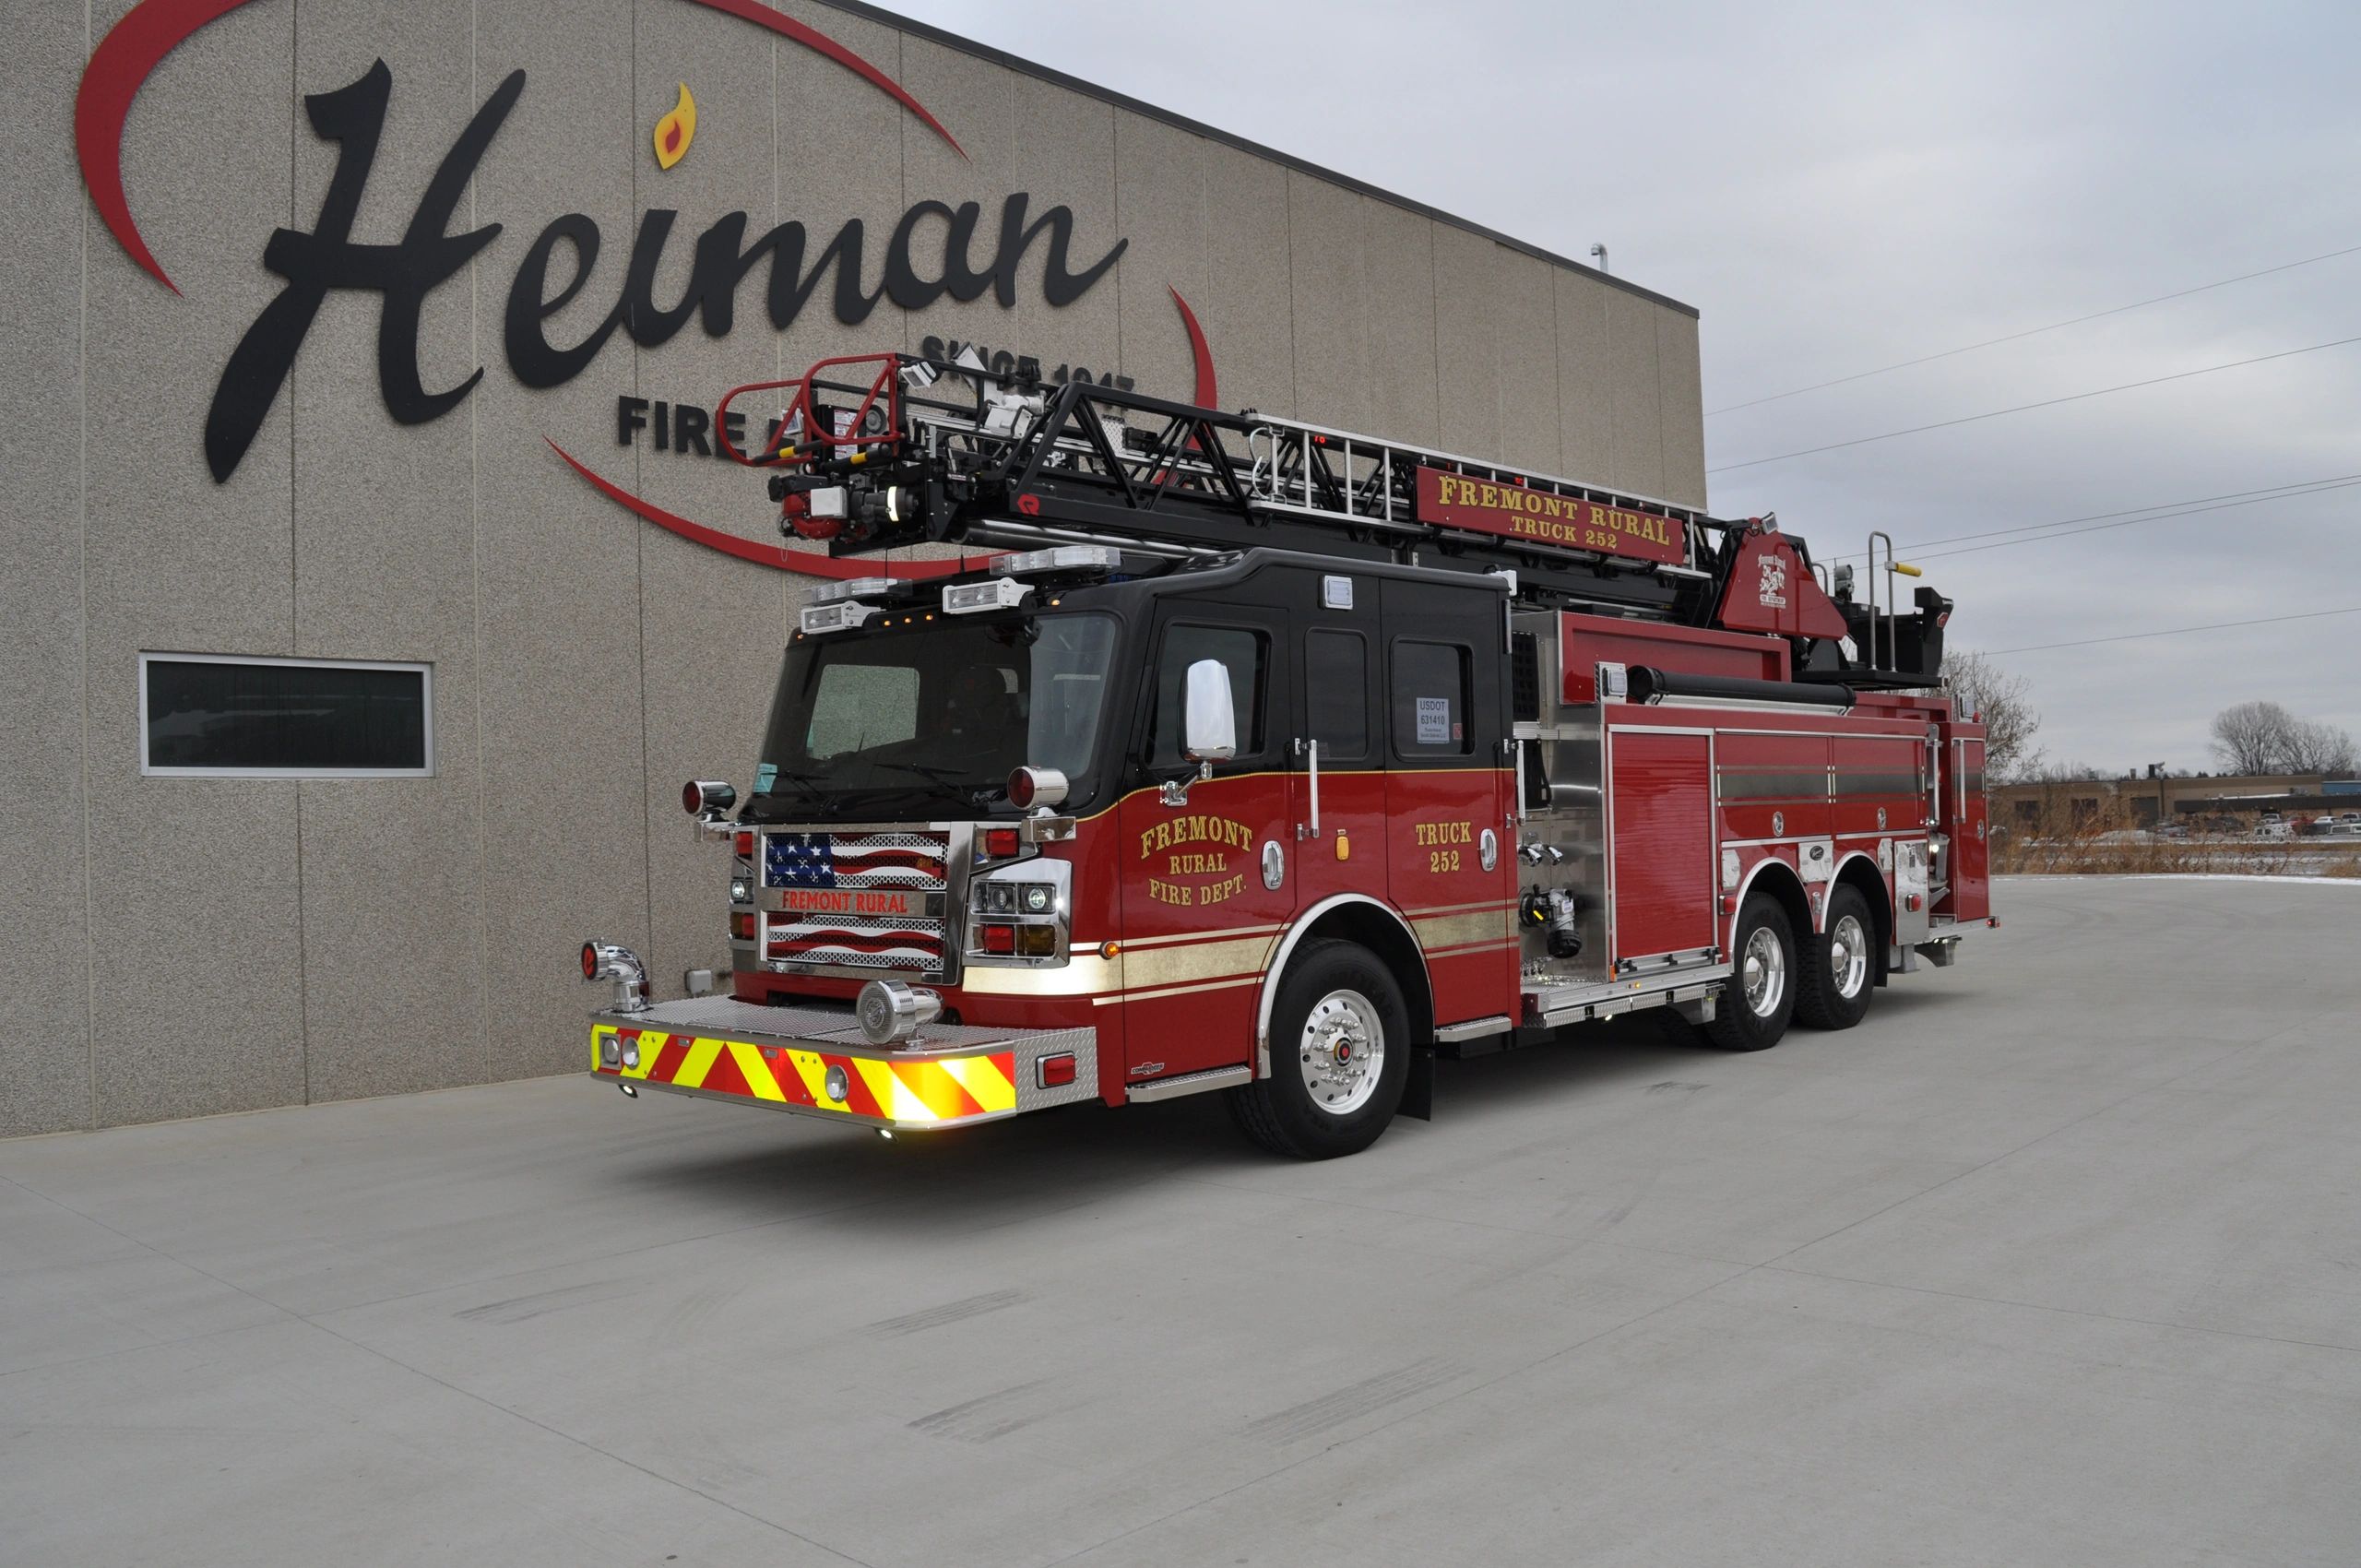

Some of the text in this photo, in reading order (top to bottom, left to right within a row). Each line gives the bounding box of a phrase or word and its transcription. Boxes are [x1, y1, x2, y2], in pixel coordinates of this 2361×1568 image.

[205, 57, 1130, 484] Heiman
[619, 395, 747, 458] FIRE
[1438, 475, 1670, 546] FREMONT RURAL
[1511, 515, 1619, 550] TRUCK 252
[1420, 700, 1445, 711] USDOT
[1420, 715, 1445, 725] 631410
[1140, 815, 1252, 860] FREMONT
[1416, 821, 1472, 846] TRUCK
[1169, 853, 1228, 875] RURAL
[1430, 849, 1460, 873] 252
[782, 890, 908, 913] FREMONT RURAL
[1148, 873, 1247, 906] FIRE DEPT.
